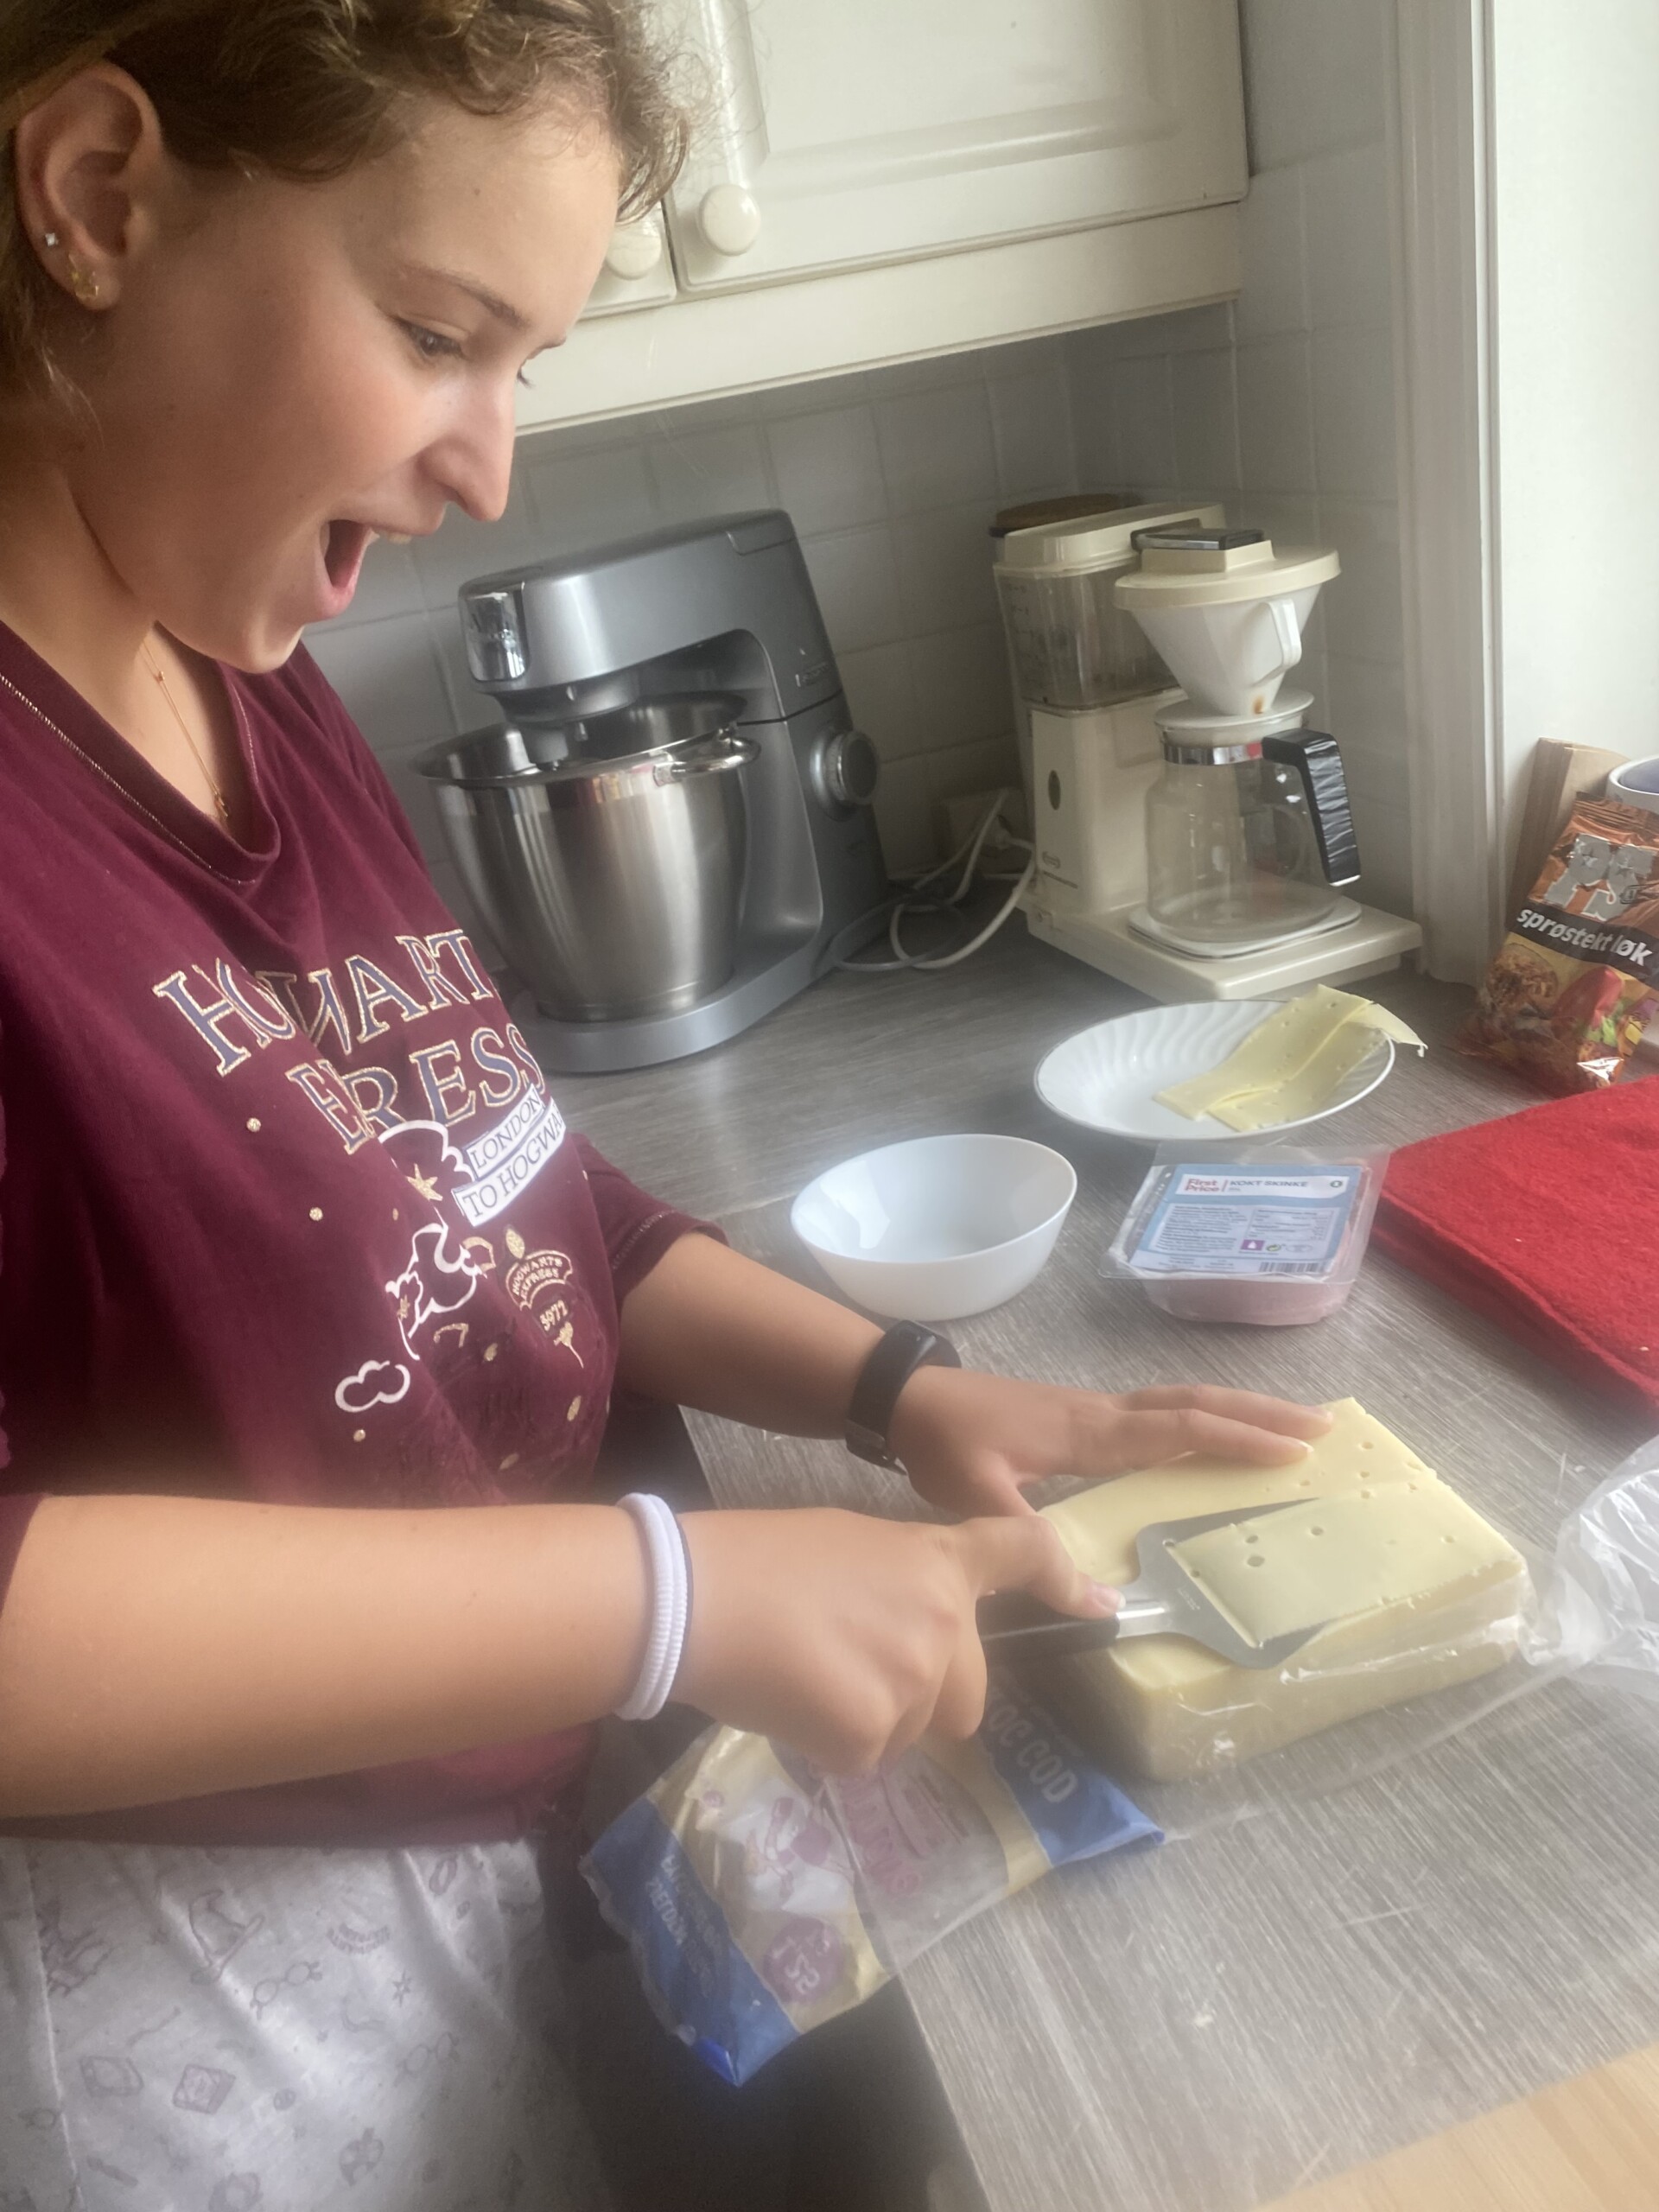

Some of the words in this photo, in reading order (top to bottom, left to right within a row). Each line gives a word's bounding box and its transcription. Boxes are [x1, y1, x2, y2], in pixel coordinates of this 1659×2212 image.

[1516, 908, 1613, 951] sprøstekt
[1611, 934, 1653, 967] løk
[152, 930, 503, 1077] HOWART
[284, 1022, 546, 1155] ERESS
[470, 1093, 542, 1170] LONDON
[461, 1184, 498, 1217] TO
[496, 1103, 563, 1198] HOGWA
[1186, 1178, 1218, 1186] First
